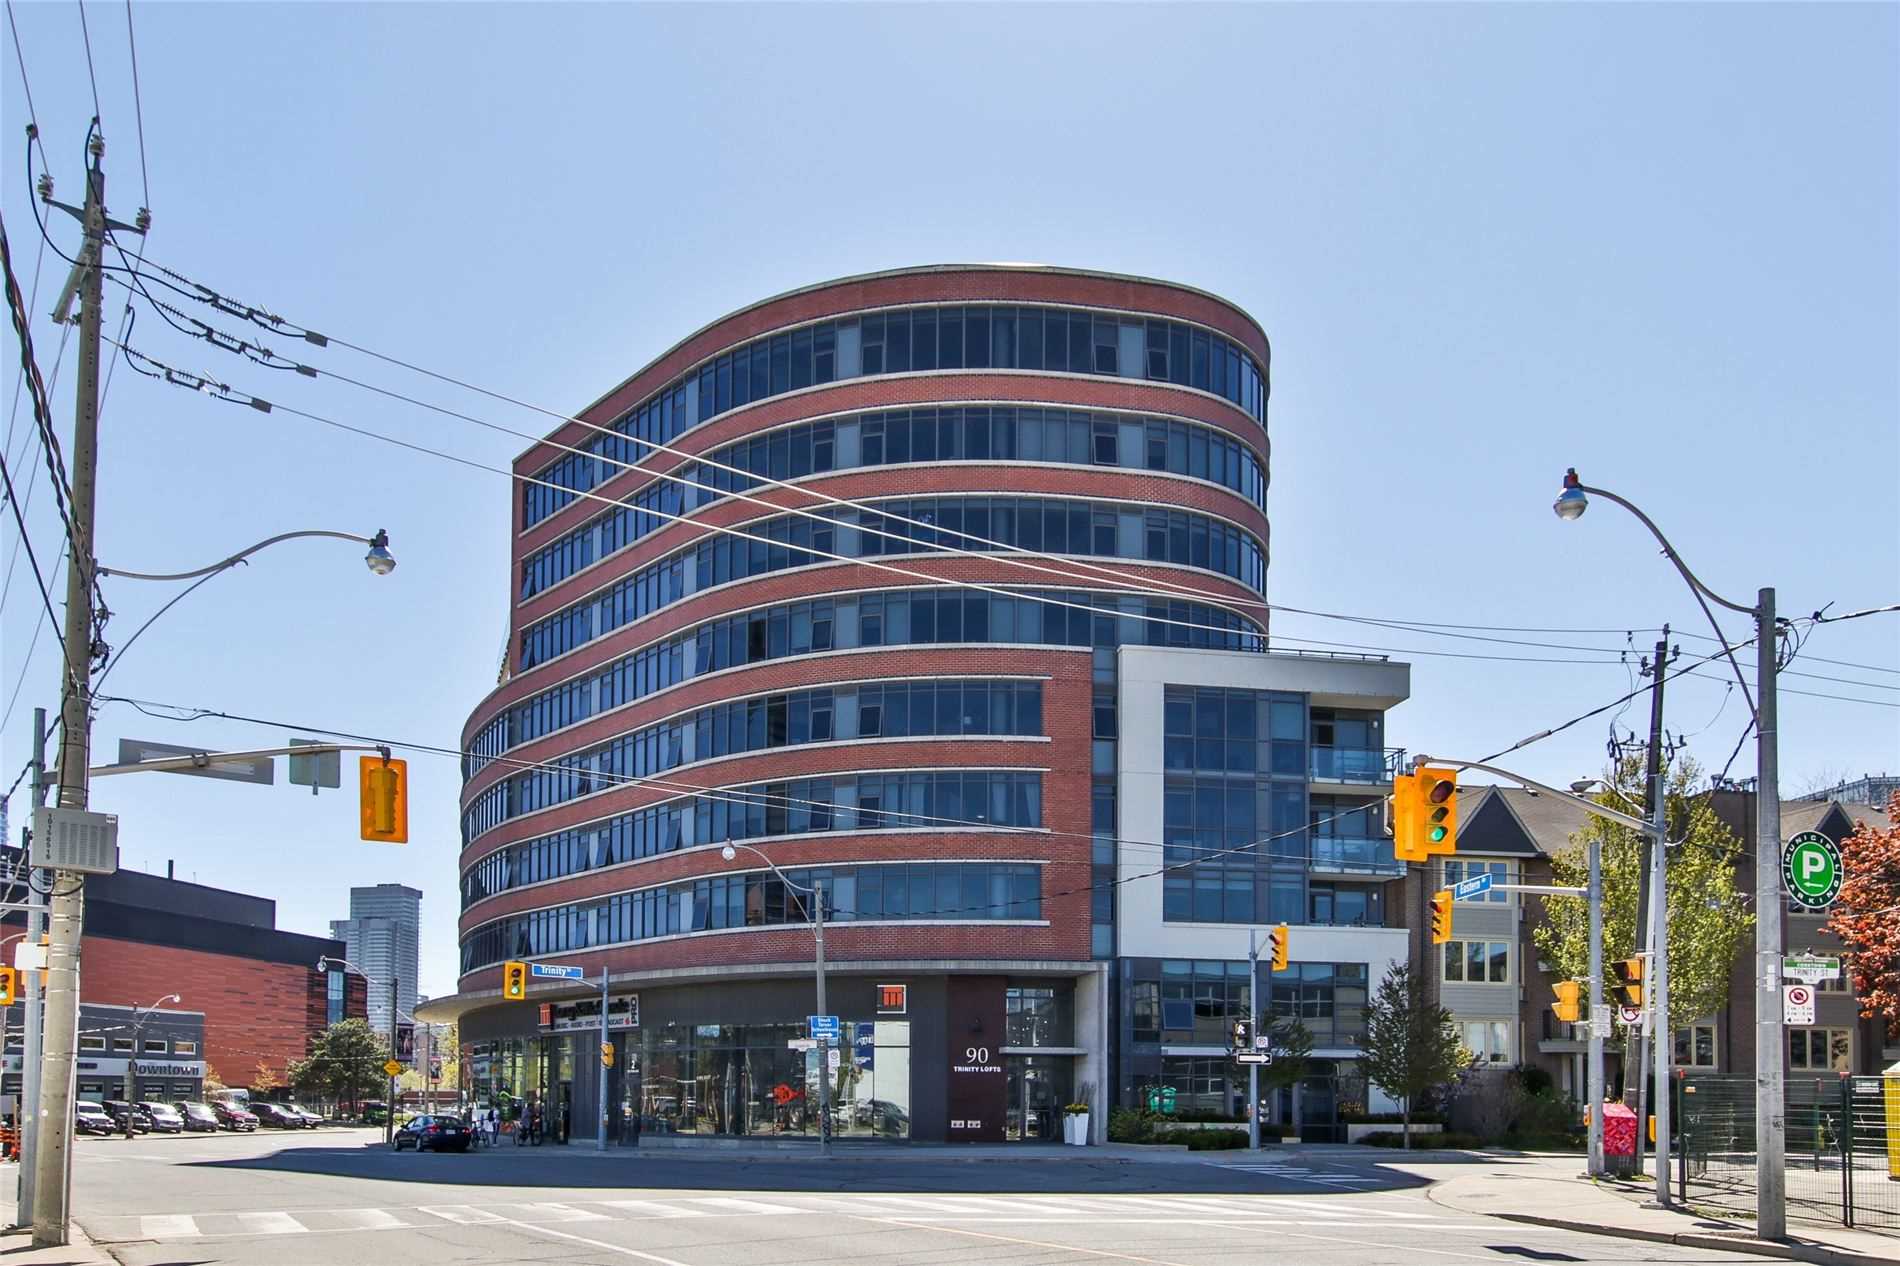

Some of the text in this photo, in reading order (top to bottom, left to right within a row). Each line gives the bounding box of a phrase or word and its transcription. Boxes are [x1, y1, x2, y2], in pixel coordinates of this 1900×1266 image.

[1785, 834, 1840, 870] MUNICIPAL
[1802, 850, 1826, 880] P
[1785, 872, 1839, 904] PARKING
[541, 966, 567, 977] Trinity
[630, 997, 638, 1025] PRO
[128, 1061, 200, 1075] Downtown
[966, 1047, 989, 1064] 90
